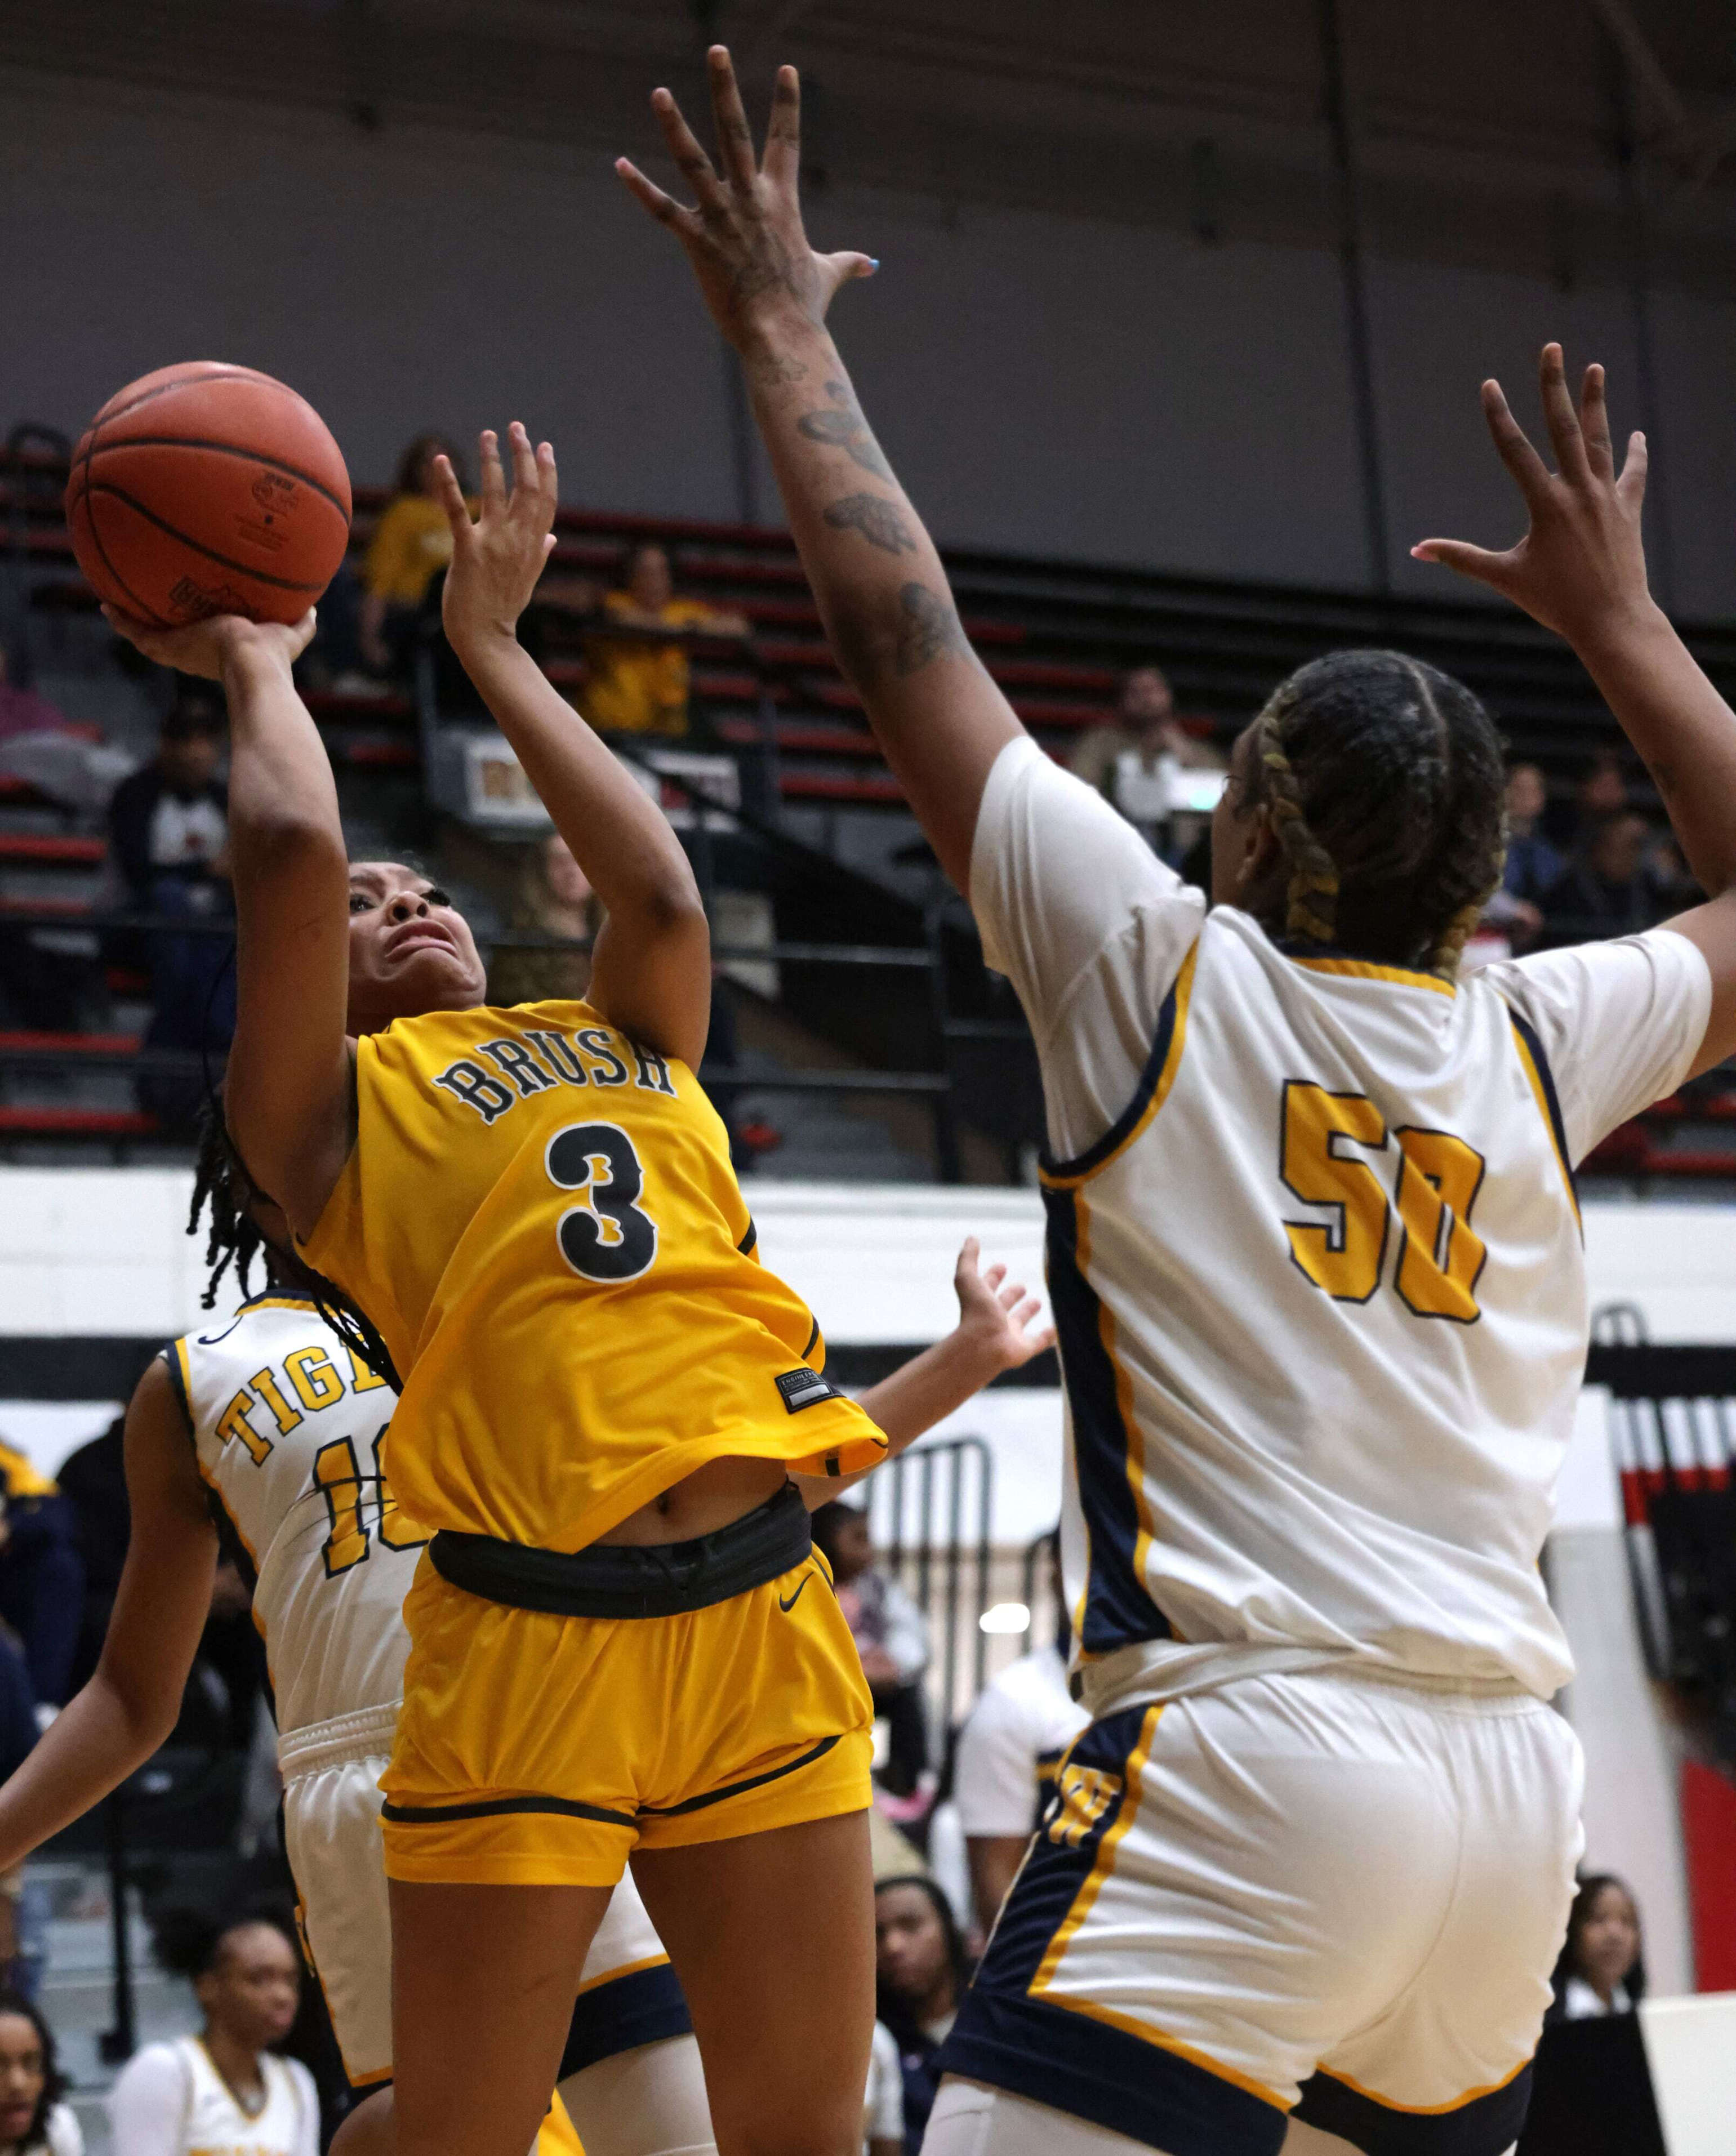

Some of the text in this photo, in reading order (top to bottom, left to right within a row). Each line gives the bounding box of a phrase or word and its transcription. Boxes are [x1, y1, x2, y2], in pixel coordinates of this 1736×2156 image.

[431, 1028, 679, 1126] BRUSH
[545, 1121, 658, 1284] 3
[1279, 1079, 1488, 1325] 50
